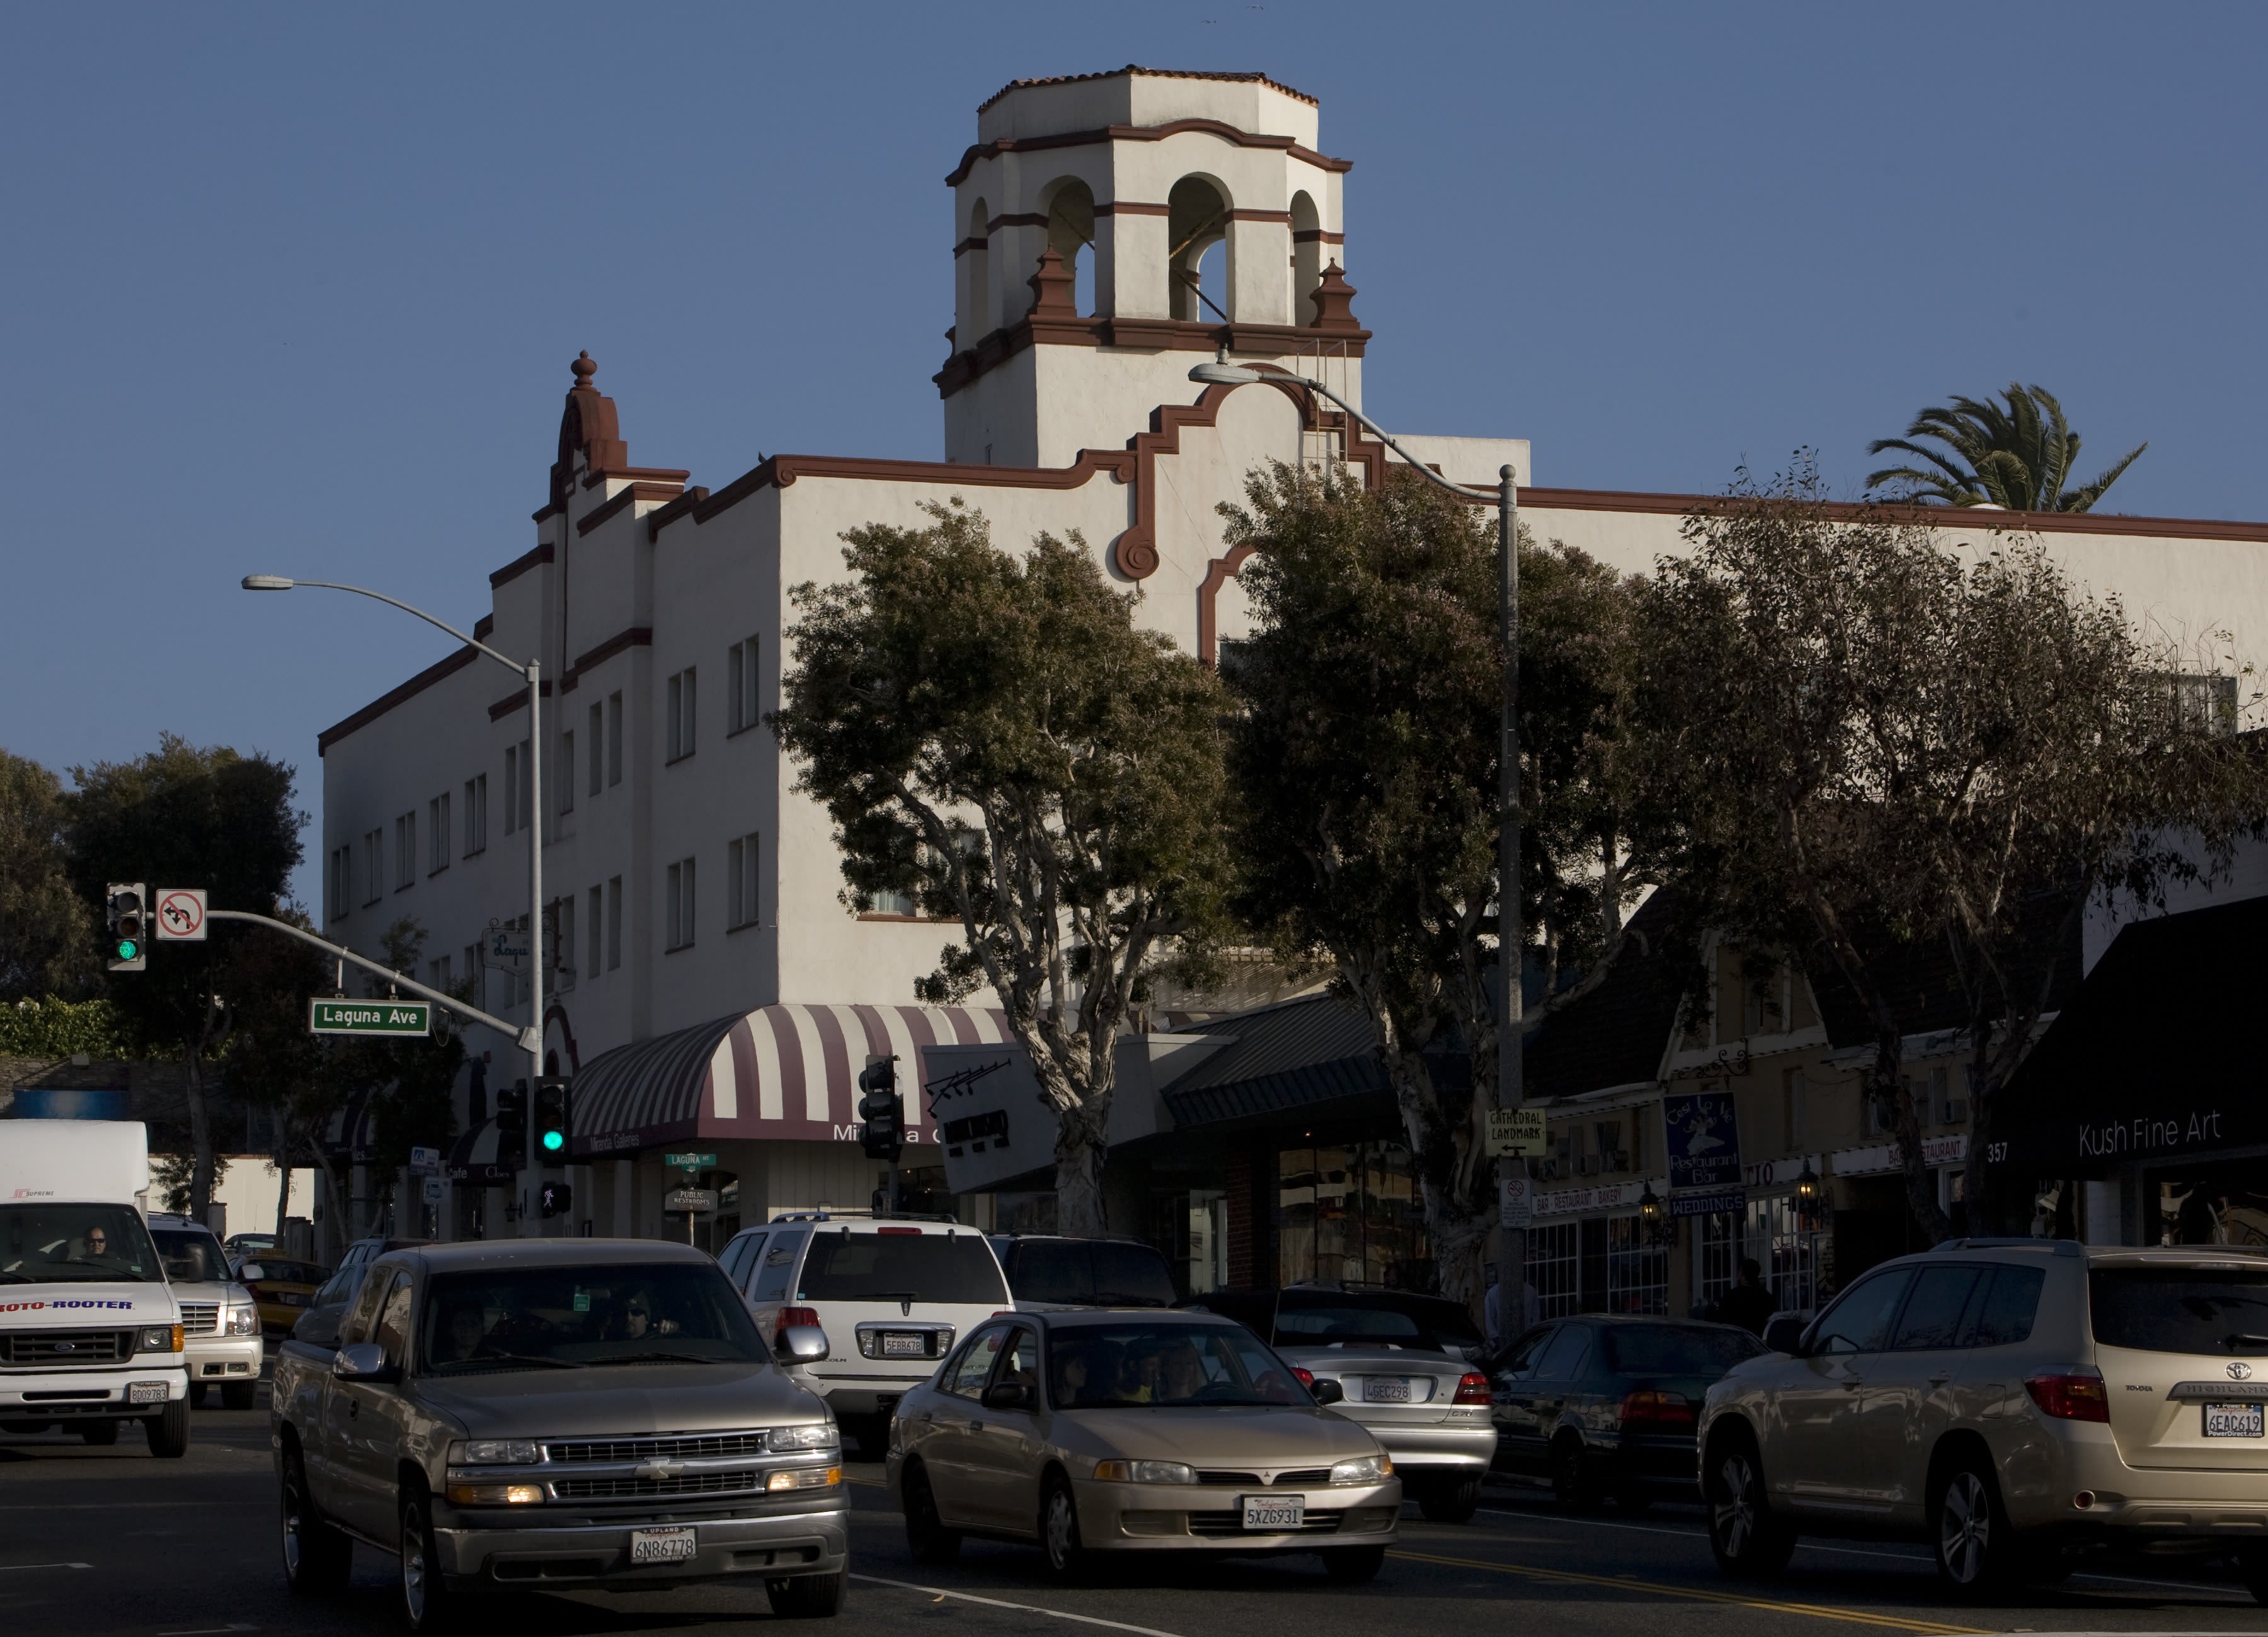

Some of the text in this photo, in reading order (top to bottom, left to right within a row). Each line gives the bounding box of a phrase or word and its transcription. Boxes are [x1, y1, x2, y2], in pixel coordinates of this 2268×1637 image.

[492, 934, 547, 966] Lagu
[323, 1007, 418, 1027] Laguna Ave
[1490, 1112, 1542, 1125] CATHEDRAL
[590, 1132, 639, 1153] Miranda Galleries
[1491, 1128, 1541, 1140] LANDMARK
[2079, 1109, 2221, 1157] Kush Fine Art
[672, 1155, 701, 1164] LAGUNA
[1921, 1140, 1961, 1160] STAURANT
[1988, 1142, 2008, 1163] 357
[1670, 1153, 1739, 1172] Restaurant
[449, 1167, 468, 1179] Cafe
[1692, 1169, 1719, 1184] Bar
[1743, 1162, 1773, 1185] TIO
[680, 1190, 704, 1199] PUBLIC
[1537, 1189, 1622, 1211] BAR RESTAURANT BAKERY
[1673, 1195, 1744, 1215] WEDDINGS
[886, 1340, 921, 1351] 5EBB678
[1368, 1385, 1409, 1398] 4GEC298
[2209, 1415, 2260, 1431] 6EAC619
[1247, 1509, 1299, 1524] 5XZG931
[635, 1539, 694, 1558] 6N86778
